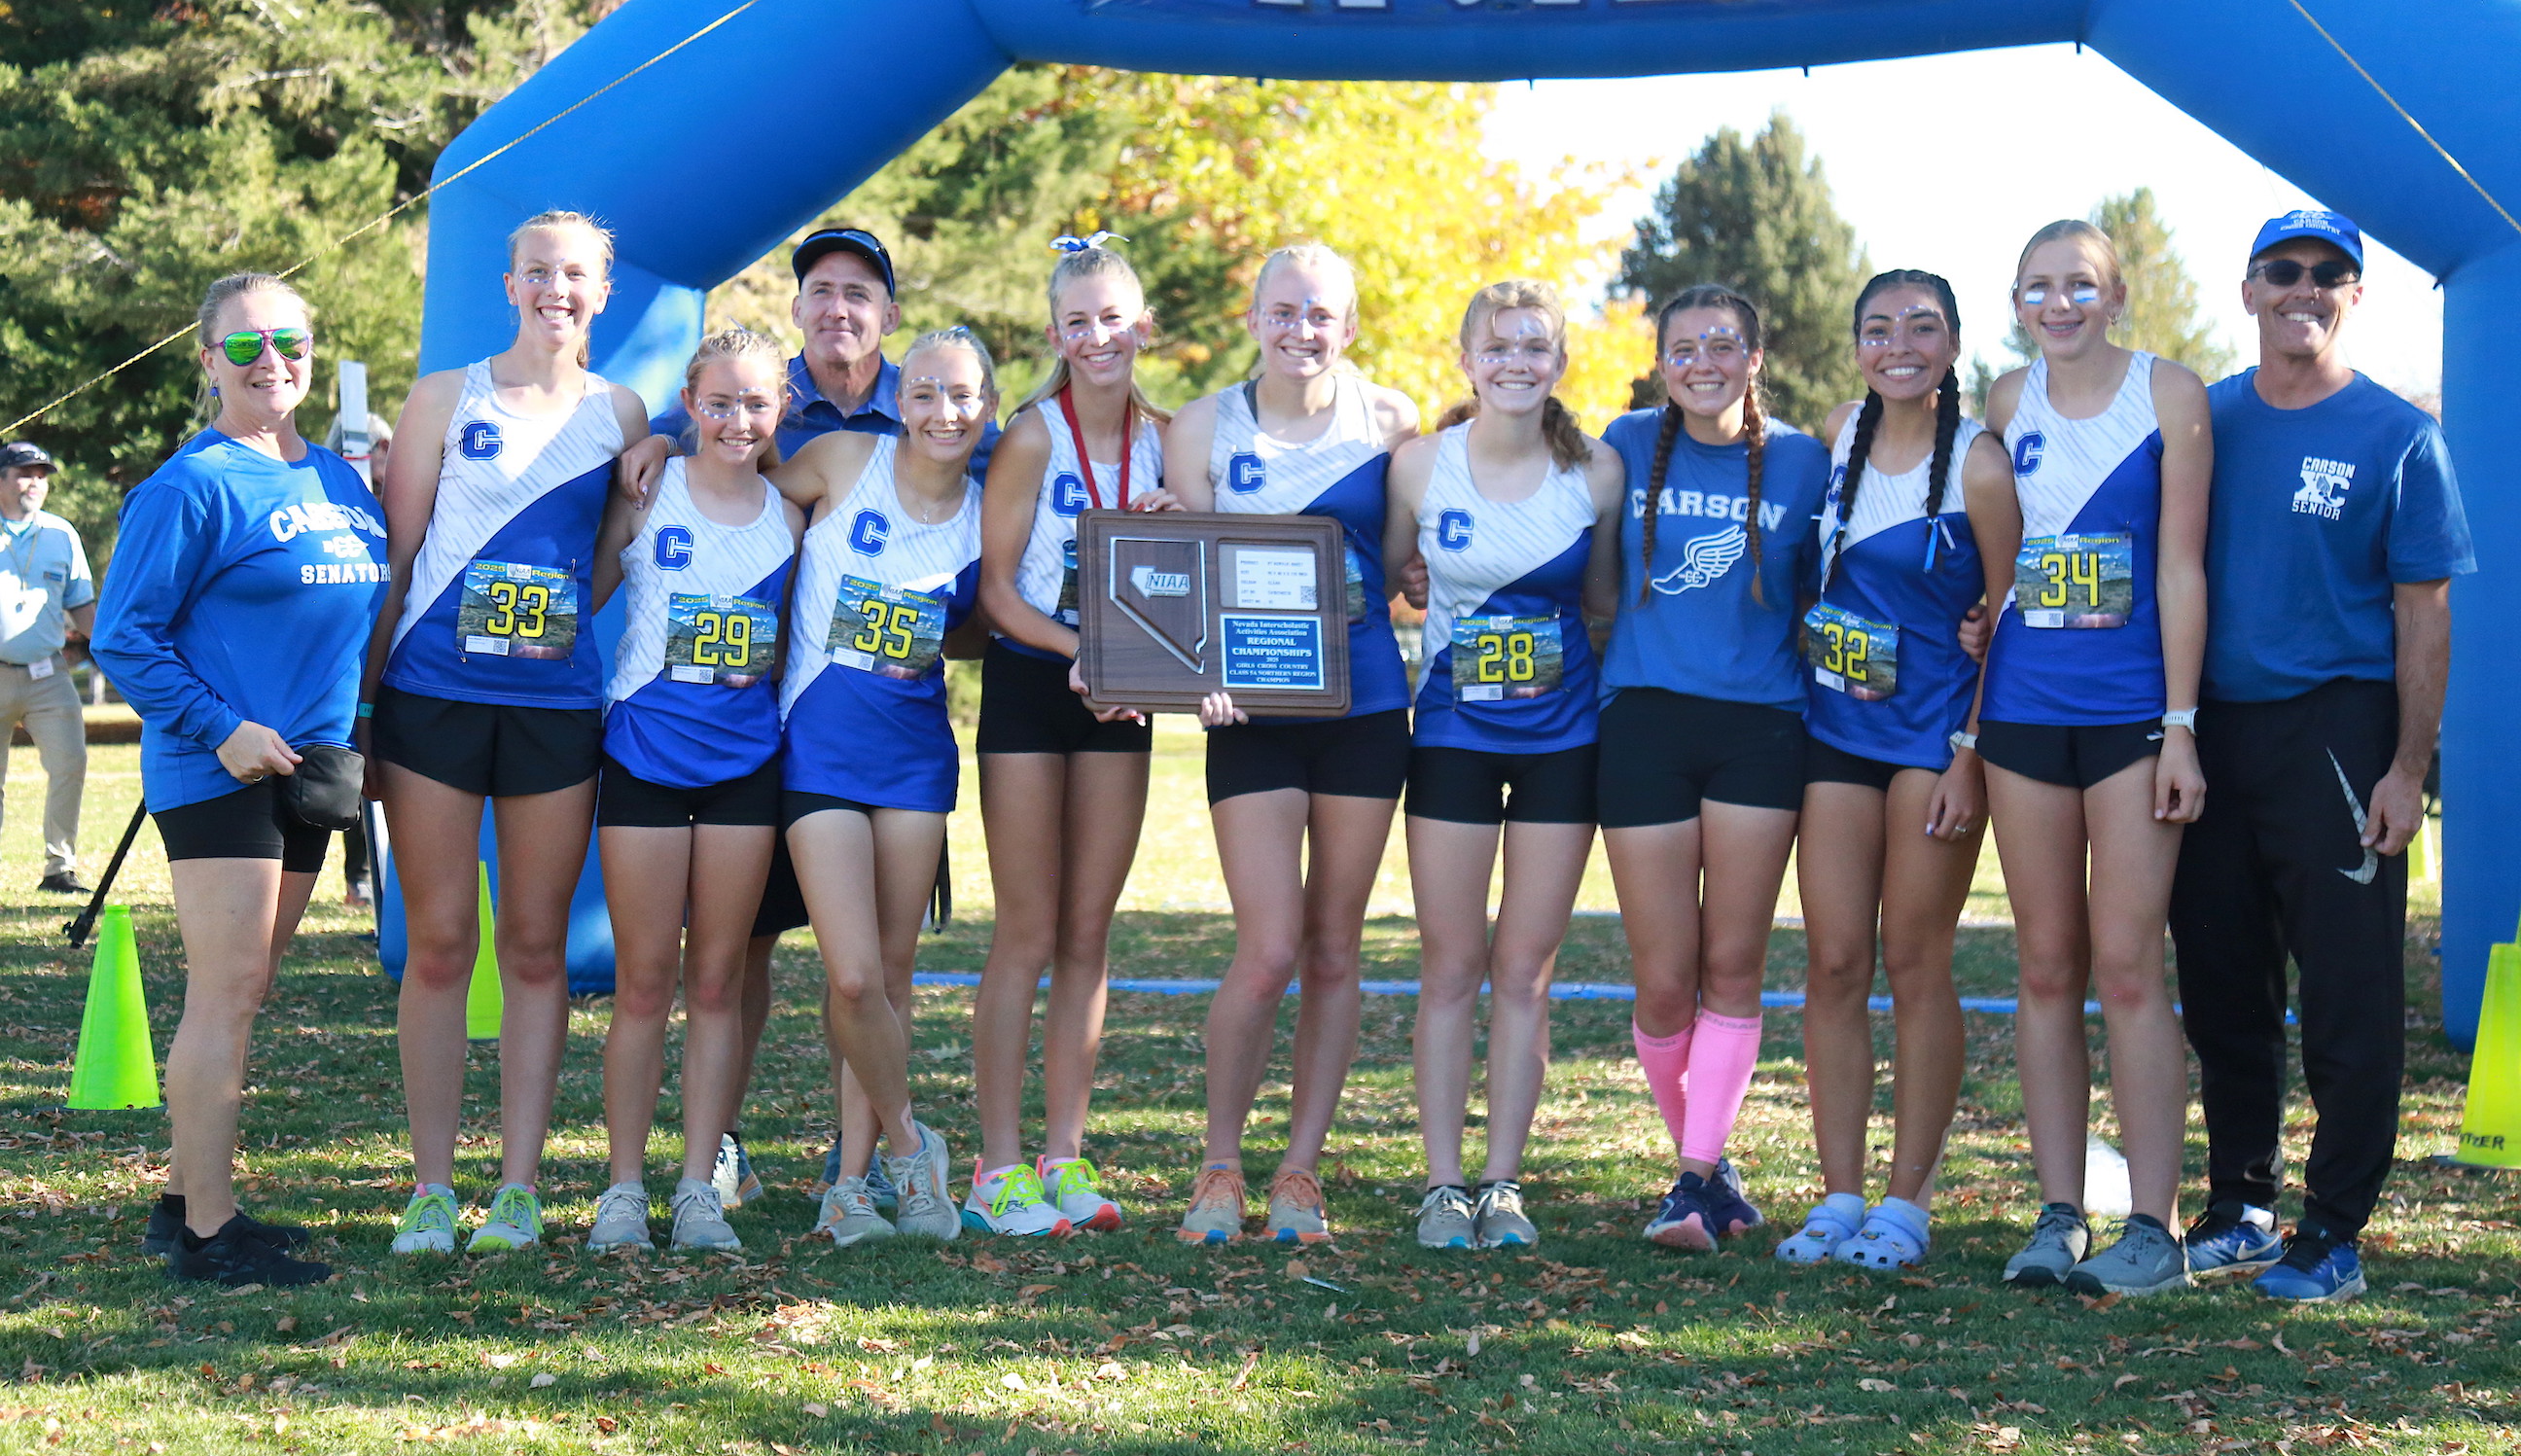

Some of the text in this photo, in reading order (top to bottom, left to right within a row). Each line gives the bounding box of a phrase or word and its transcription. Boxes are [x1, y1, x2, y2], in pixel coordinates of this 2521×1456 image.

[459, 420, 503, 461] C
[2013, 430, 2046, 479] C
[1228, 451, 1264, 495] C
[2302, 456, 2356, 479] CARSON
[1050, 471, 1088, 517] C
[1631, 487, 1788, 533] CARSON
[2291, 500, 2341, 520] SENIOR
[269, 502, 388, 543] CARSON
[847, 508, 891, 557] C
[1438, 508, 1474, 552] C
[2079, 536, 2120, 545] Region
[653, 524, 693, 571] C
[475, 563, 507, 573] 2025
[531, 569, 570, 580] Region
[1149, 575, 1189, 588] NIAA
[2041, 552, 2099, 607] 34
[486, 581, 550, 639] 33
[733, 598, 766, 610] Region
[904, 590, 939, 606] Region
[692, 612, 752, 667] 29
[854, 599, 918, 659] 35
[1246, 637, 1297, 647] REGIONAL
[1260, 621, 1310, 629] Interscholastic
[1231, 647, 1313, 657] CHAMPIONSHIPS
[1477, 632, 1535, 683] 28
[1823, 621, 1869, 682] 32
